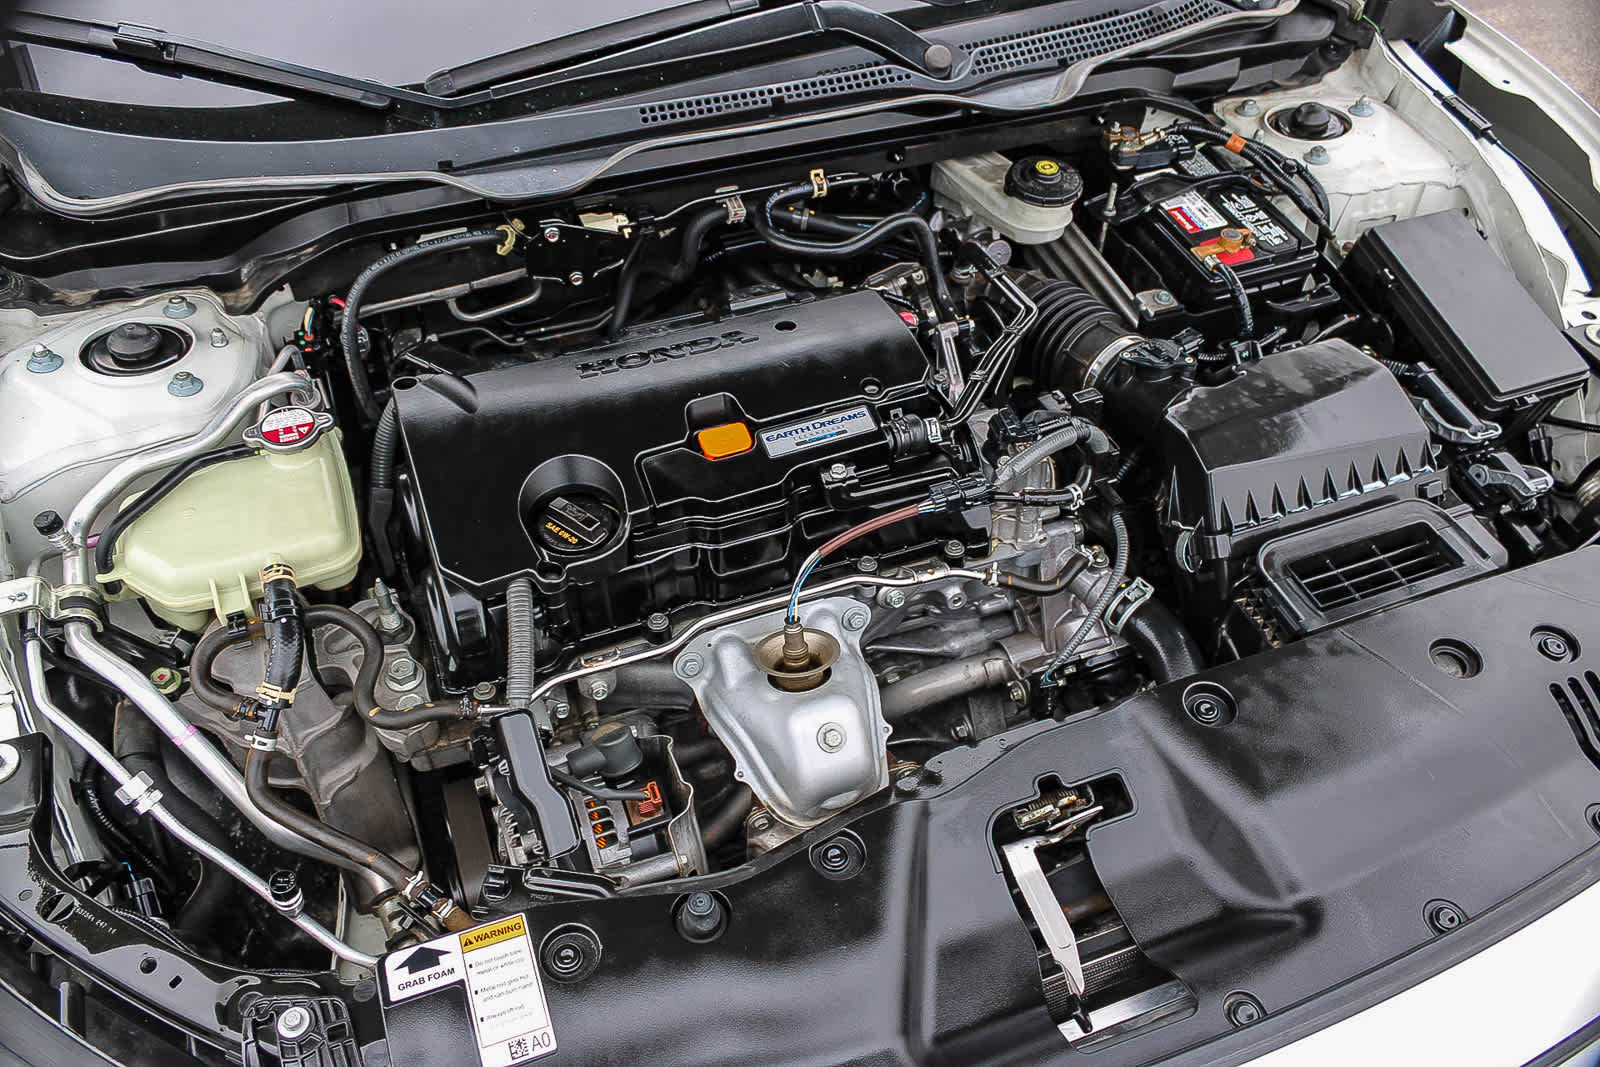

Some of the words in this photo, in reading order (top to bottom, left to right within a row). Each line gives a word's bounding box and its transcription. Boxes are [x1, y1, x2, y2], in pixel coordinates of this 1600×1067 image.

[575, 330, 759, 379] HONDA
[765, 425, 811, 442] EARTH
[812, 410, 867, 430] DREAMS
[545, 521, 560, 533] SAE
[559, 530, 578, 544] 0W-20
[473, 922, 522, 942] WARNING
[397, 976, 426, 992] GRAB
[427, 967, 456, 983] FOAM
[532, 1032, 551, 1052] A0
